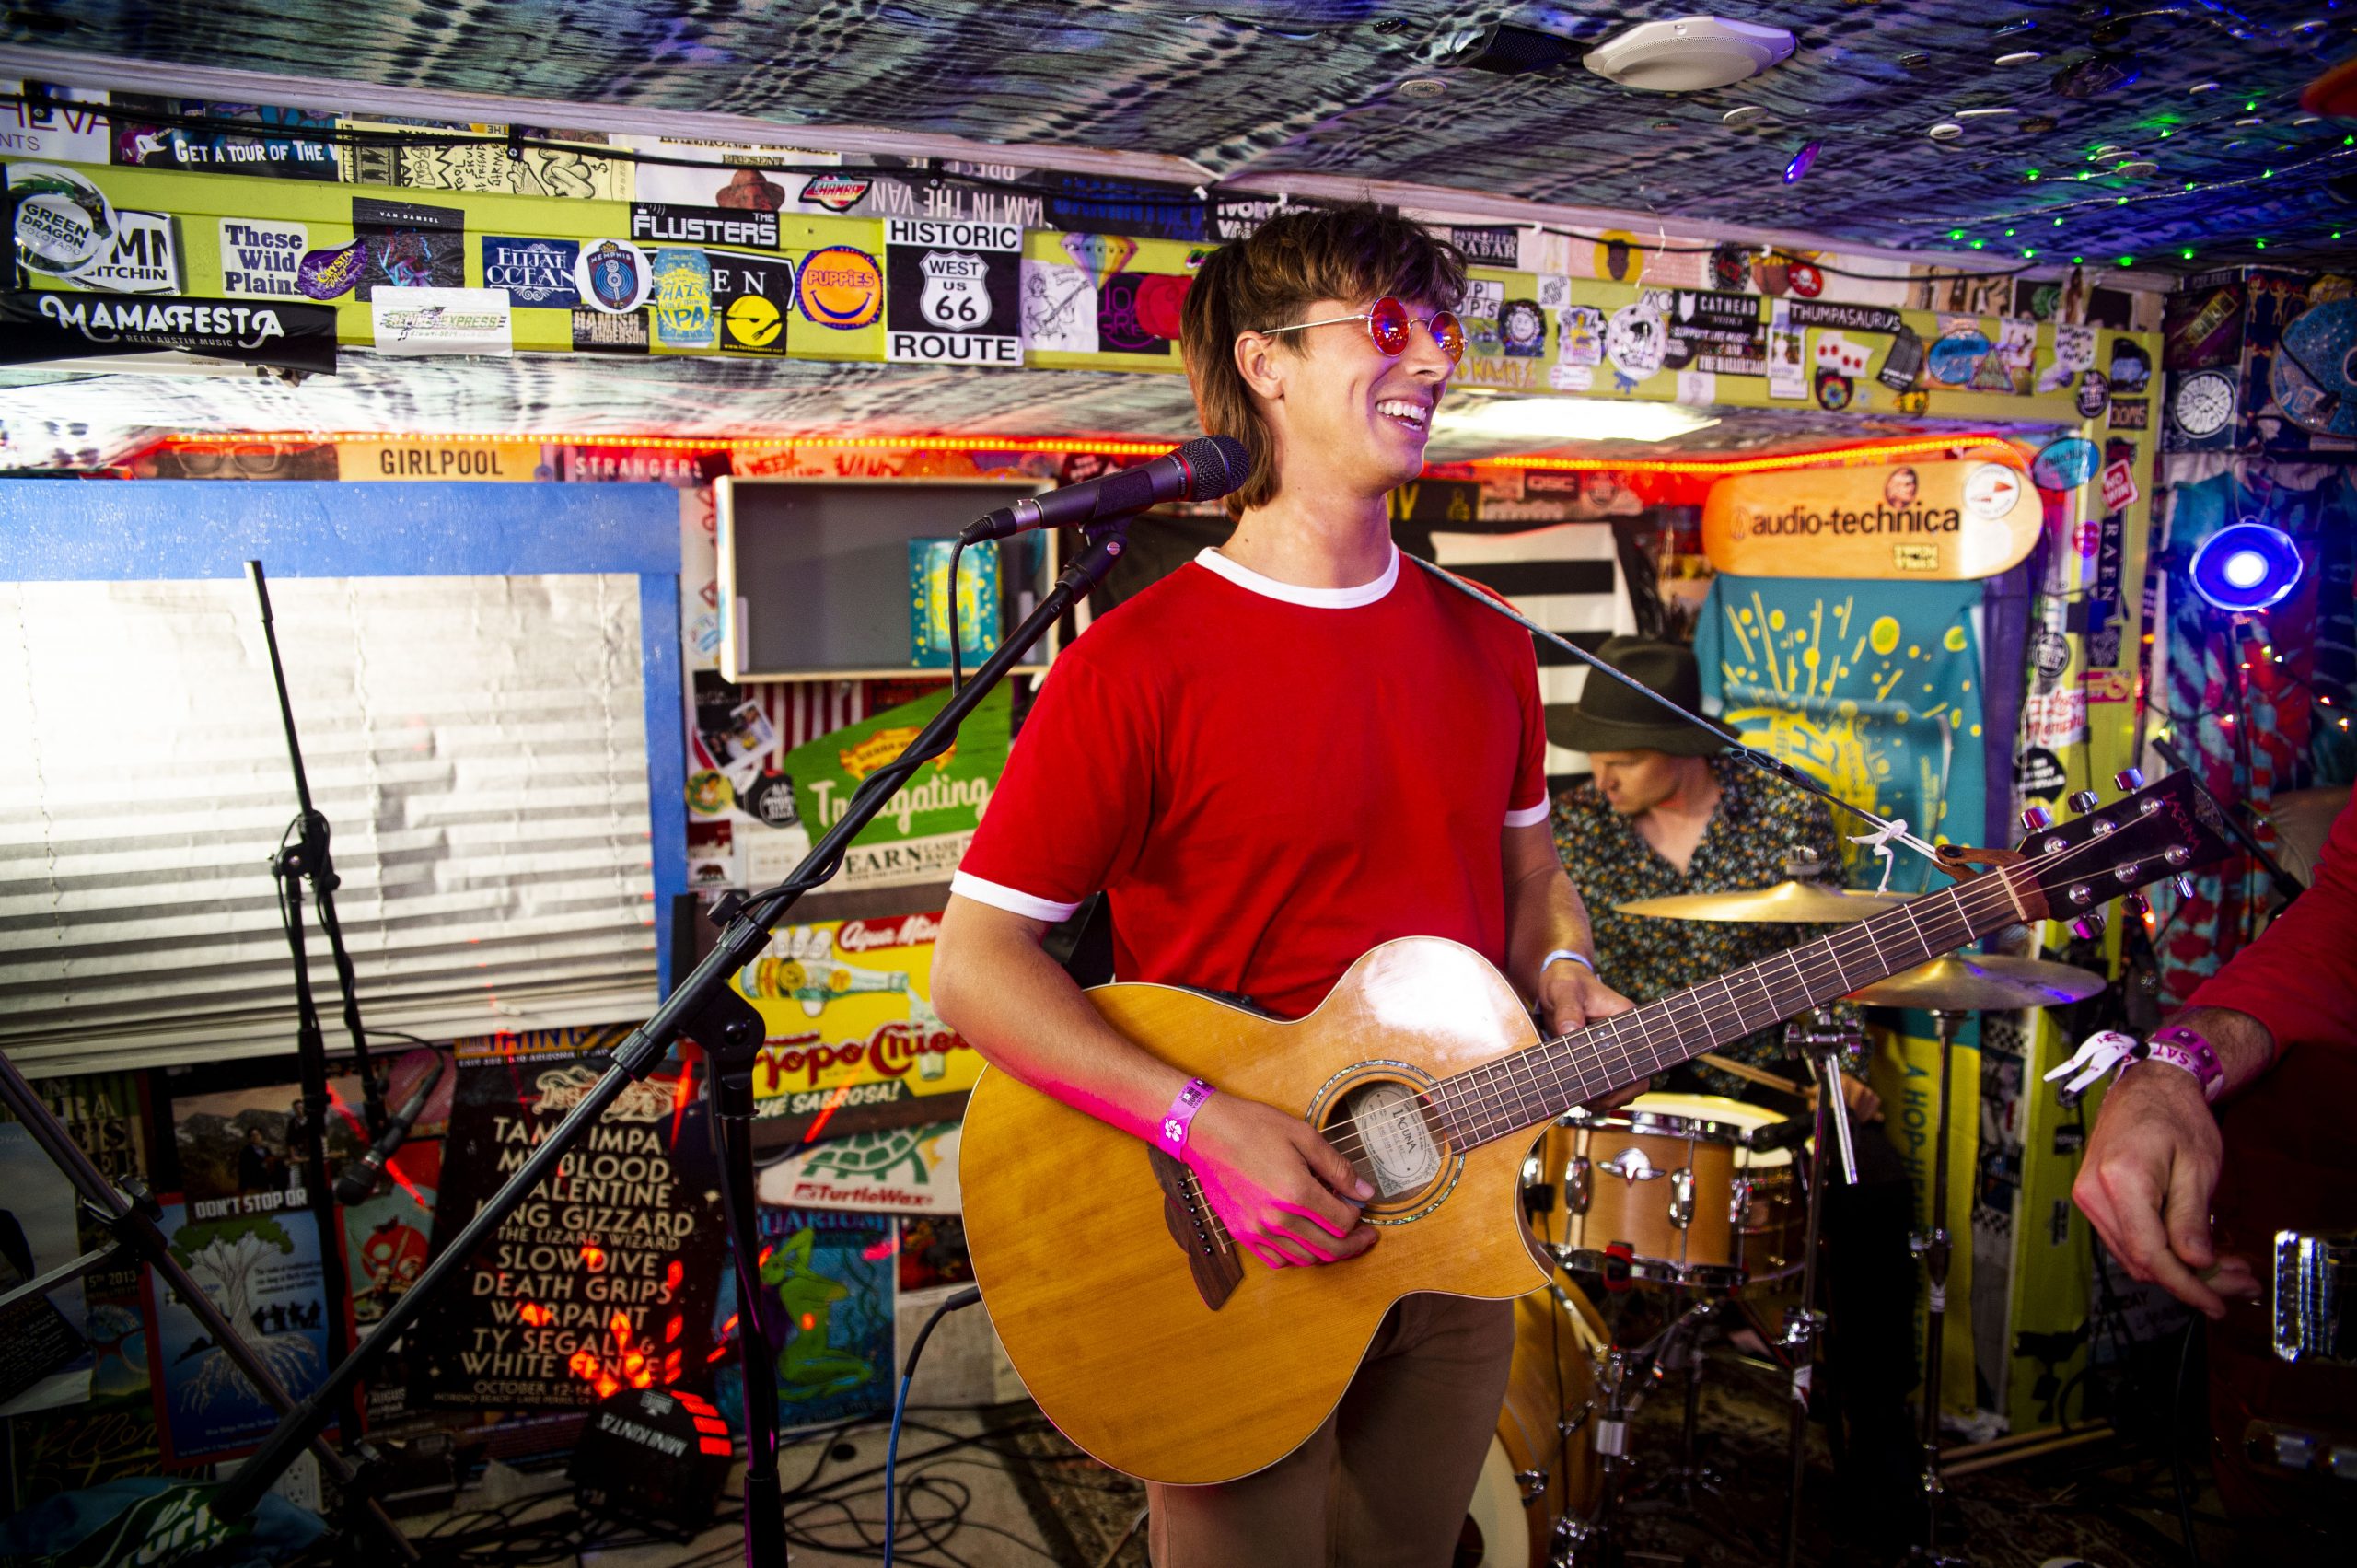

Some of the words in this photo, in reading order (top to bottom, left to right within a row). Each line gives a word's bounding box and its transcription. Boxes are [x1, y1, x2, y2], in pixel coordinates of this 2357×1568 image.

[174, 139, 208, 162] GET
[215, 145, 225, 163] A
[227, 145, 267, 163] TOUR
[270, 144, 288, 161] OF
[293, 140, 325, 162] THE
[871, 180, 915, 217] VAN
[923, 186, 965, 220] THE
[24, 203, 90, 238] GREEN
[379, 211, 399, 220] VAN
[403, 214, 440, 224] DAMSEL
[754, 213, 775, 223] THE
[20, 214, 86, 250] DRAGON
[224, 224, 304, 250] These
[889, 220, 1019, 250] HISTORIC
[238, 248, 297, 273] Wild
[497, 247, 568, 270] ELIJAH
[590, 251, 633, 264] MEMPHIS
[928, 260, 981, 276] WEST
[85, 264, 168, 281] ITCHIN
[224, 271, 306, 297] Plains
[486, 265, 575, 288] OCEAN
[942, 280, 968, 292] US
[662, 306, 706, 328] IPA
[935, 295, 978, 322] 66
[1699, 296, 1759, 317] CATHEAD
[1791, 302, 1902, 332] THUMPASAURUS
[39, 294, 285, 350] MAMAFESTA
[574, 311, 639, 330] HAMISH
[125, 333, 155, 344] REAL
[157, 336, 196, 346] AUSTIN
[199, 338, 234, 348] MUSIC
[893, 334, 1018, 362] ROUTE
[379, 449, 504, 475] GIRLPOOL
[1752, 502, 1961, 536] audio-technica
[844, 845, 922, 875] EARN
[1393, 1108, 1418, 1156] LAGUNA
[508, 1175, 674, 1208] ALENTINE
[194, 1198, 241, 1221] DON'T
[243, 1191, 284, 1213] STOP
[284, 1189, 308, 1208] OR
[561, 1207, 695, 1237] GIZZARD
[497, 1226, 532, 1241] THE
[536, 1227, 603, 1246] LIZARD
[609, 1232, 681, 1252] WIZARD
[496, 1244, 660, 1277] SLOWDIVE
[108, 1271, 138, 1286] 2013
[472, 1271, 575, 1299] DEATH
[586, 1275, 672, 1305] GRIPS
[490, 1299, 650, 1330] WARPAINT
[472, 1328, 512, 1352] TY
[520, 1331, 627, 1356] SEGALL
[639, 1336, 656, 1356] &
[460, 1351, 557, 1378] WHITE
[473, 1379, 546, 1397] OCTOBER
